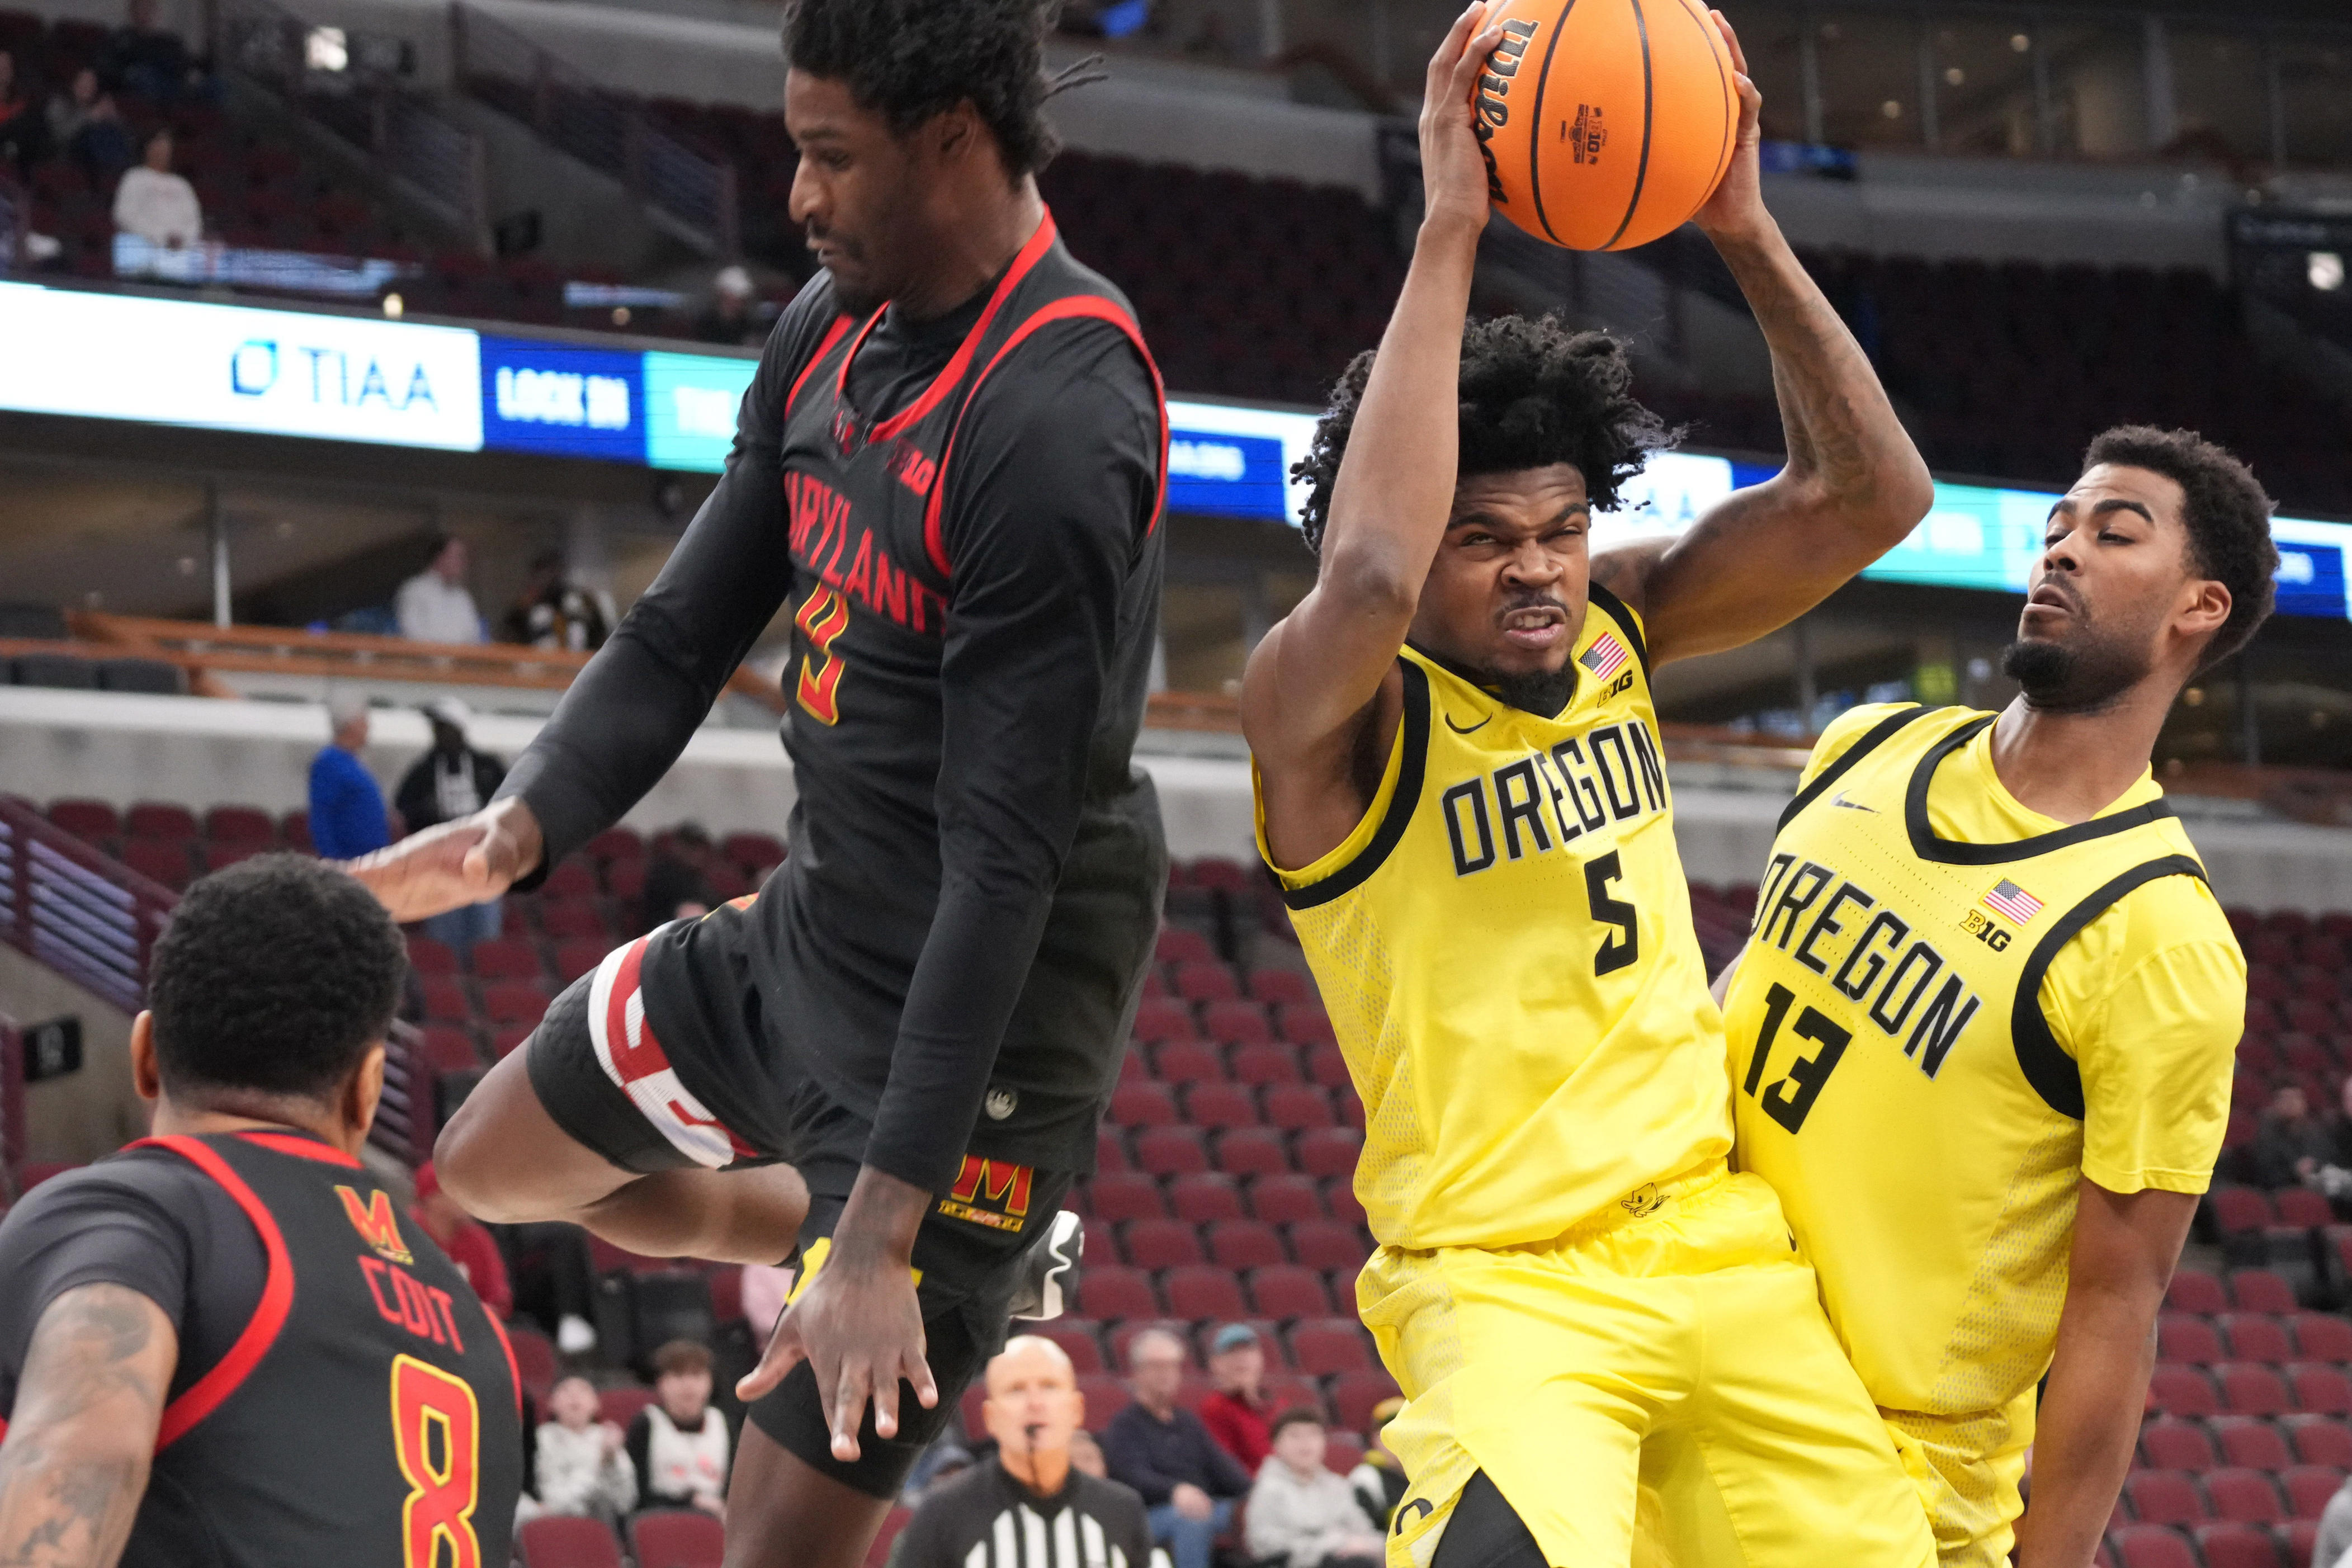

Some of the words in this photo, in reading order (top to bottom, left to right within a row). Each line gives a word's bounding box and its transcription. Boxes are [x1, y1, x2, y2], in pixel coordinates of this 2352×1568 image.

[299, 345, 440, 414] TIAA
[1440, 720, 1666, 878] OREGON
[1584, 849, 1638, 977] 5
[1752, 853, 1983, 1082] OREGON
[1744, 981, 1853, 1135] 13
[334, 1184, 411, 1254] M
[358, 1255, 465, 1354] COIT
[390, 1353, 481, 1568] 8
